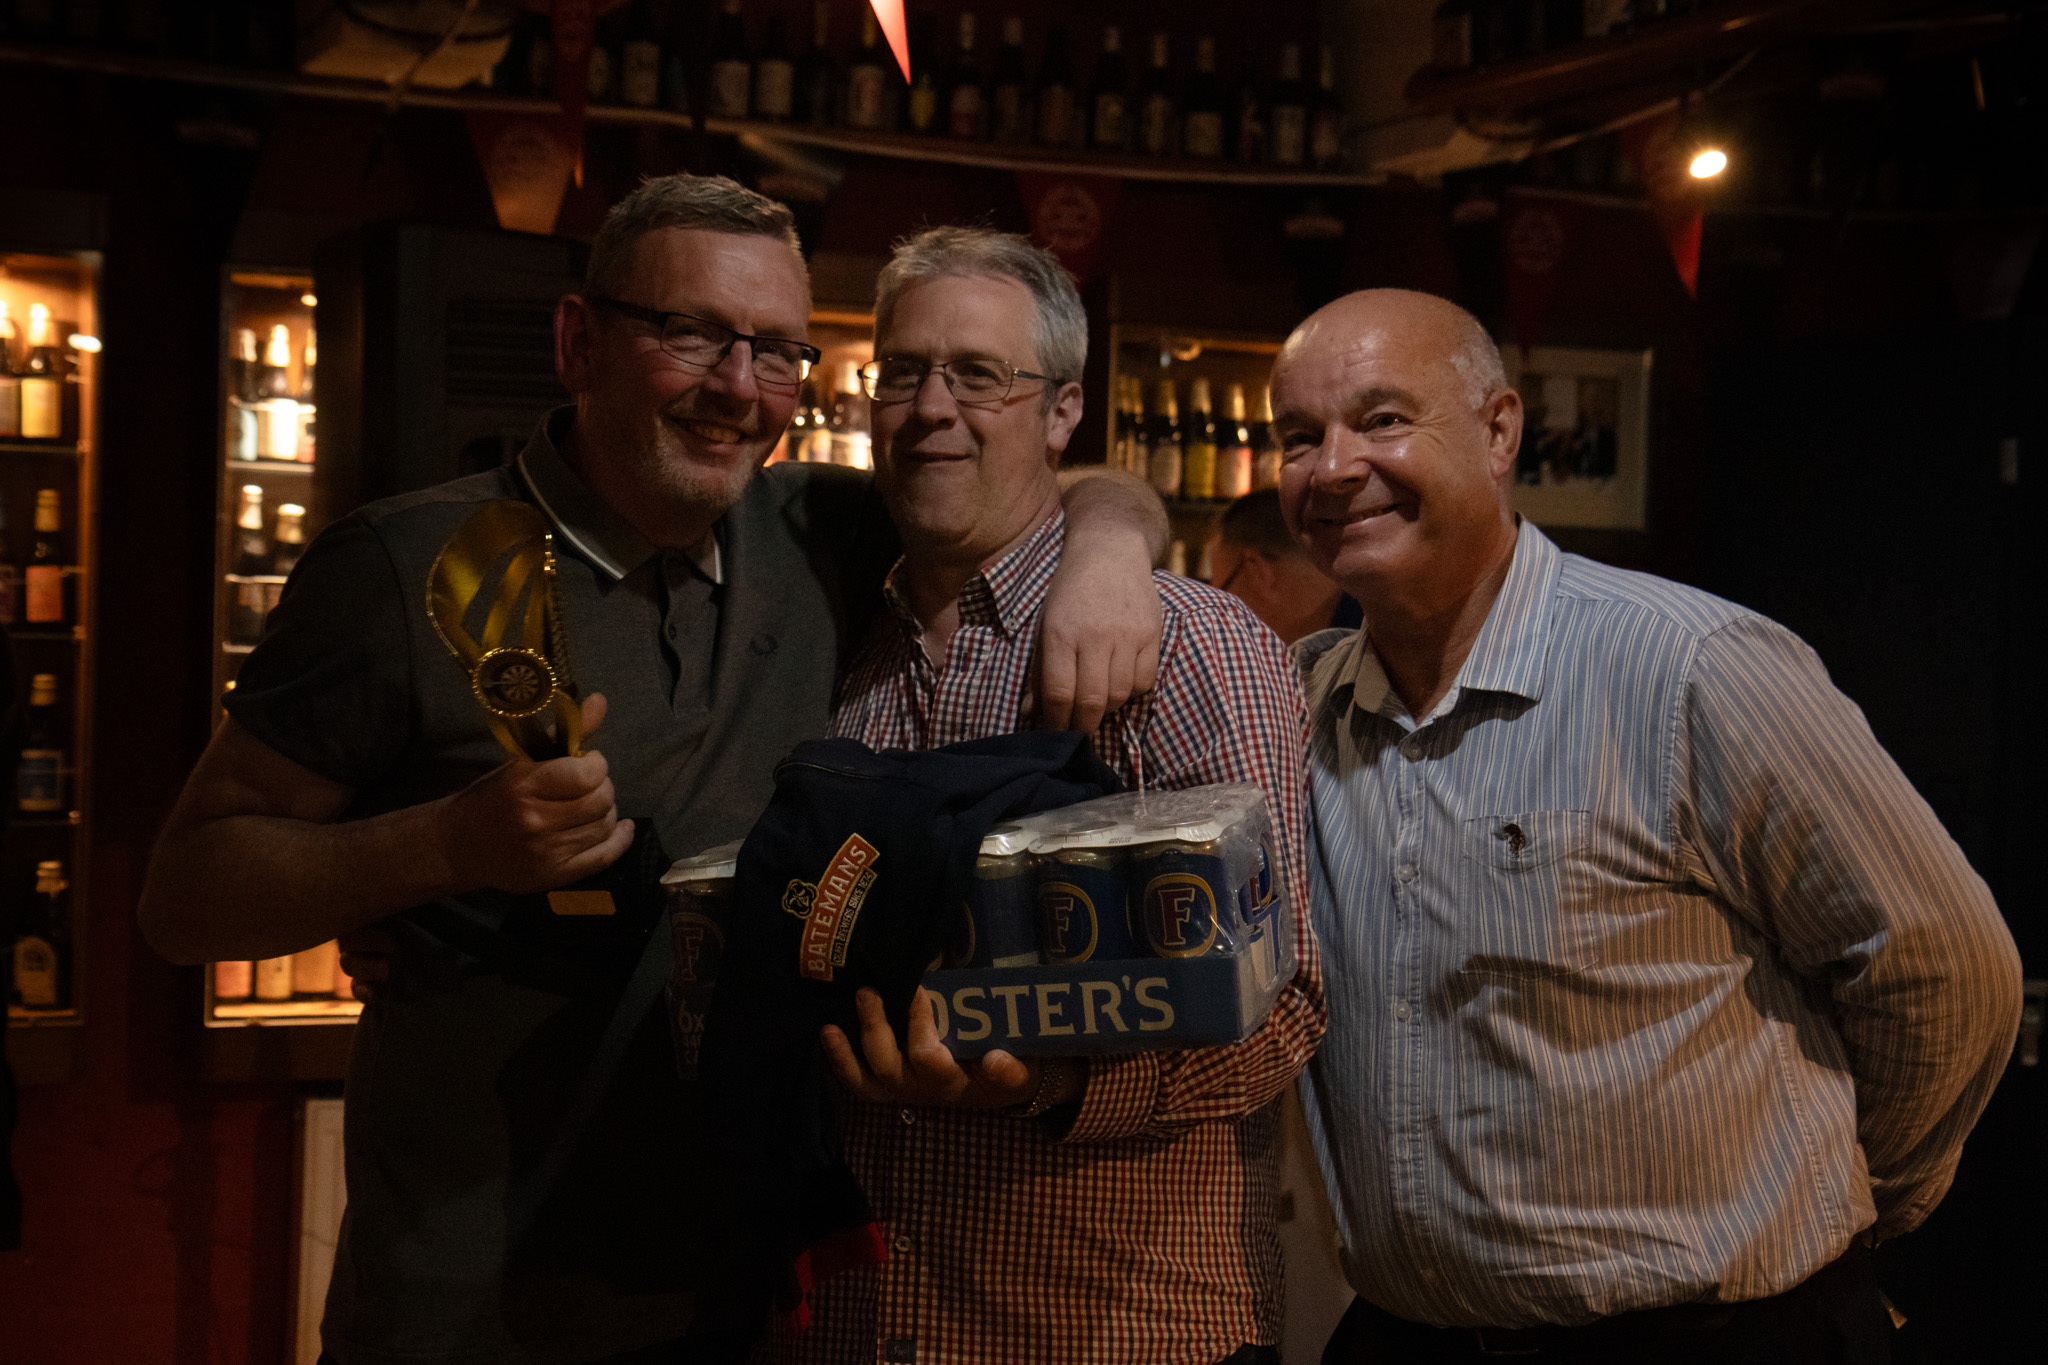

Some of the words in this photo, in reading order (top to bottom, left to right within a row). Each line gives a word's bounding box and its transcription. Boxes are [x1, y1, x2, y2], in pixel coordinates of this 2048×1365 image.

[807, 845, 867, 973] BATEMANS
[837, 908, 855, 941] BREWERS
[848, 888, 865, 909] SINCE
[1046, 896, 1075, 954] F
[1157, 887, 1196, 947] F
[677, 927, 704, 982] F
